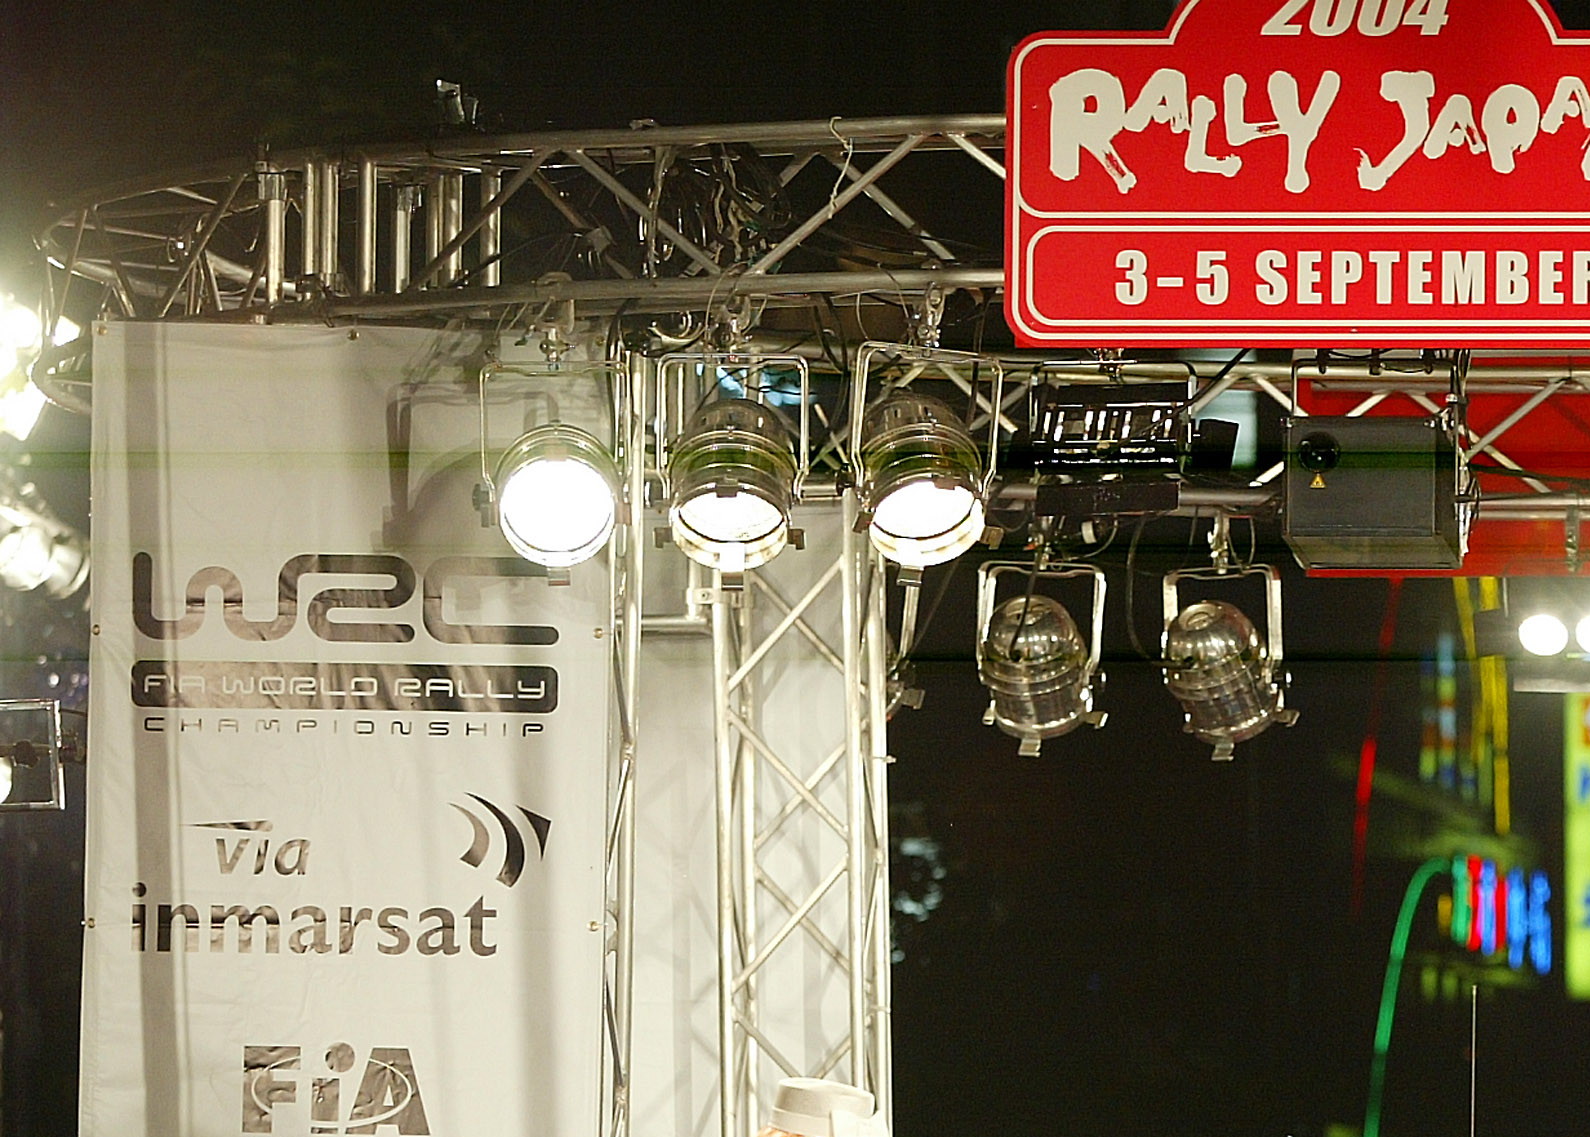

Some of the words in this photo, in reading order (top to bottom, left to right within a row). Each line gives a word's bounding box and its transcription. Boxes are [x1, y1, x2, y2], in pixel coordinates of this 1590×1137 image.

[1261, 0, 1449, 36] 2004
[1048, 68, 1341, 194] RALLY
[131, 550, 560, 646] WRC
[143, 674, 207, 696] FIA
[222, 676, 379, 699] WORLD
[394, 677, 547, 700] RALLY
[143, 716, 545, 739] CHAMPIONSHIP
[214, 837, 311, 877] via
[131, 882, 499, 957] inmarsat
